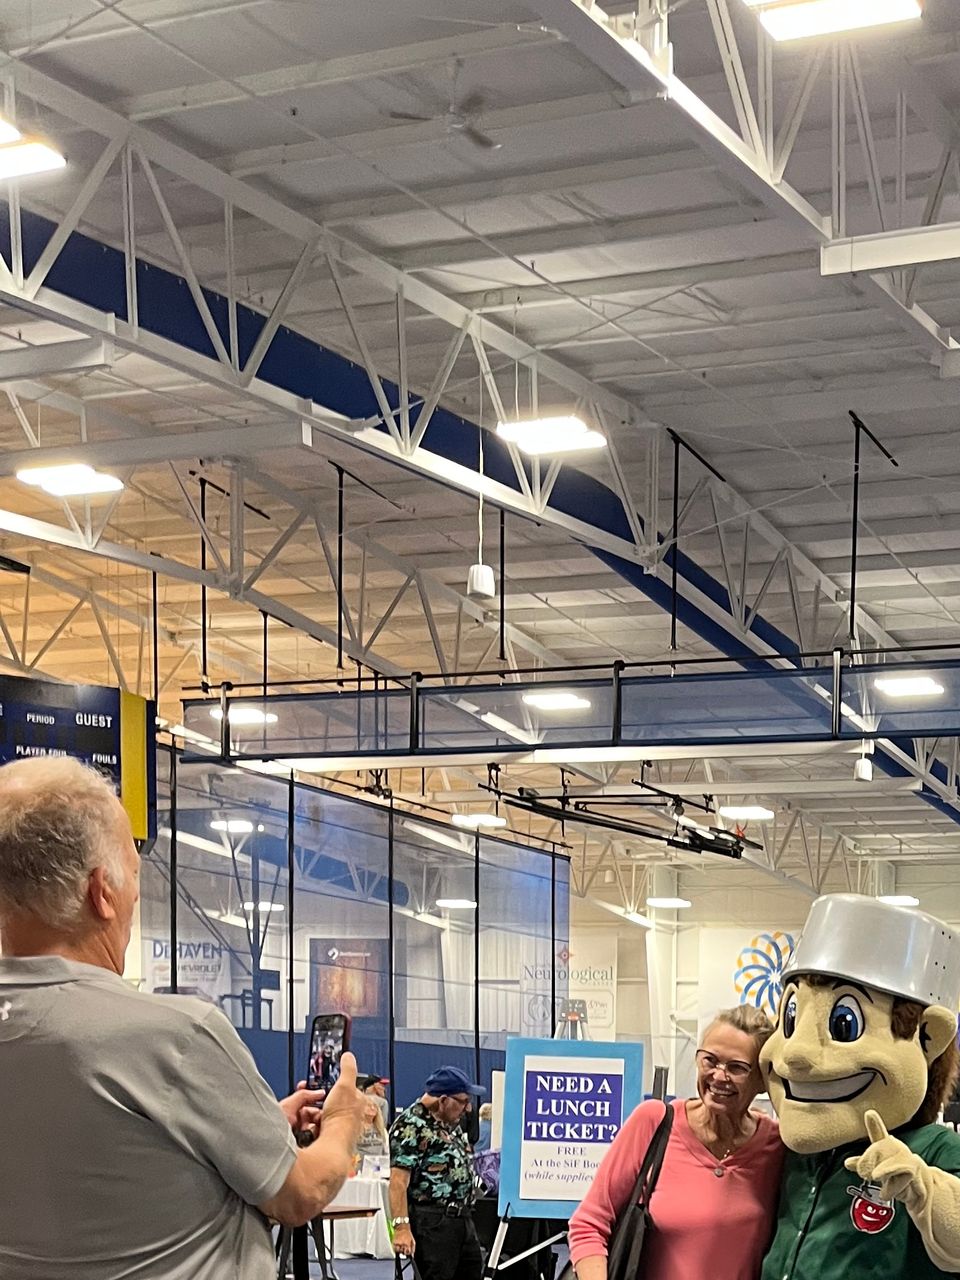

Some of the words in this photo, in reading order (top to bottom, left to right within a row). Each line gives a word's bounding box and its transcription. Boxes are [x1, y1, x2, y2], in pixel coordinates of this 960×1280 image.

[26, 712, 55, 725] PERIOD
[75, 711, 112, 728] GUEST
[92, 753, 117, 765] FOULS
[536, 1075, 594, 1094] NEED
[597, 1078, 613, 1094] A
[537, 1098, 611, 1117] LUNCH
[526, 1121, 619, 1141] TICKET?
[557, 1146, 587, 1156] FREE
[531, 1158, 543, 1168] At
[546, 1159, 562, 1169] the
